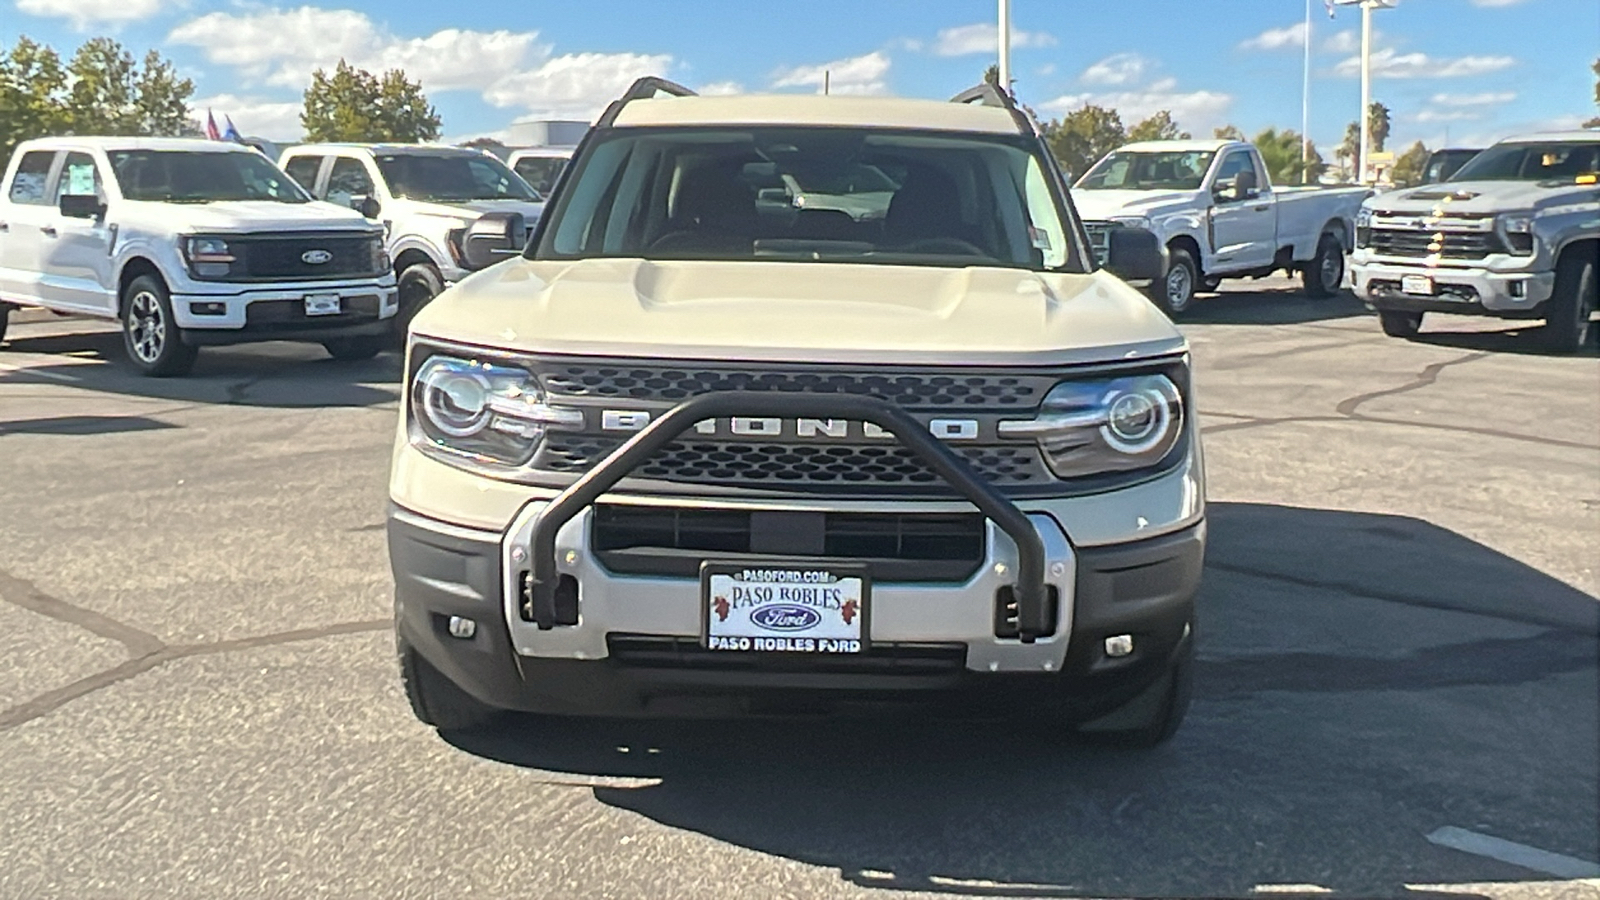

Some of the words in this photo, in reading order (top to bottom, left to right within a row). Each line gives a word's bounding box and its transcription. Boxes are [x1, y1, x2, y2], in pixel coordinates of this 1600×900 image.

[743, 570, 829, 583] PASOFORD.COM
[732, 586, 773, 609] PASO
[780, 587, 841, 610] ROBLES
[764, 609, 808, 626] Ford
[709, 636, 750, 650] PASO
[754, 637, 814, 651] ROBLES
[818, 639, 861, 652] FORD
